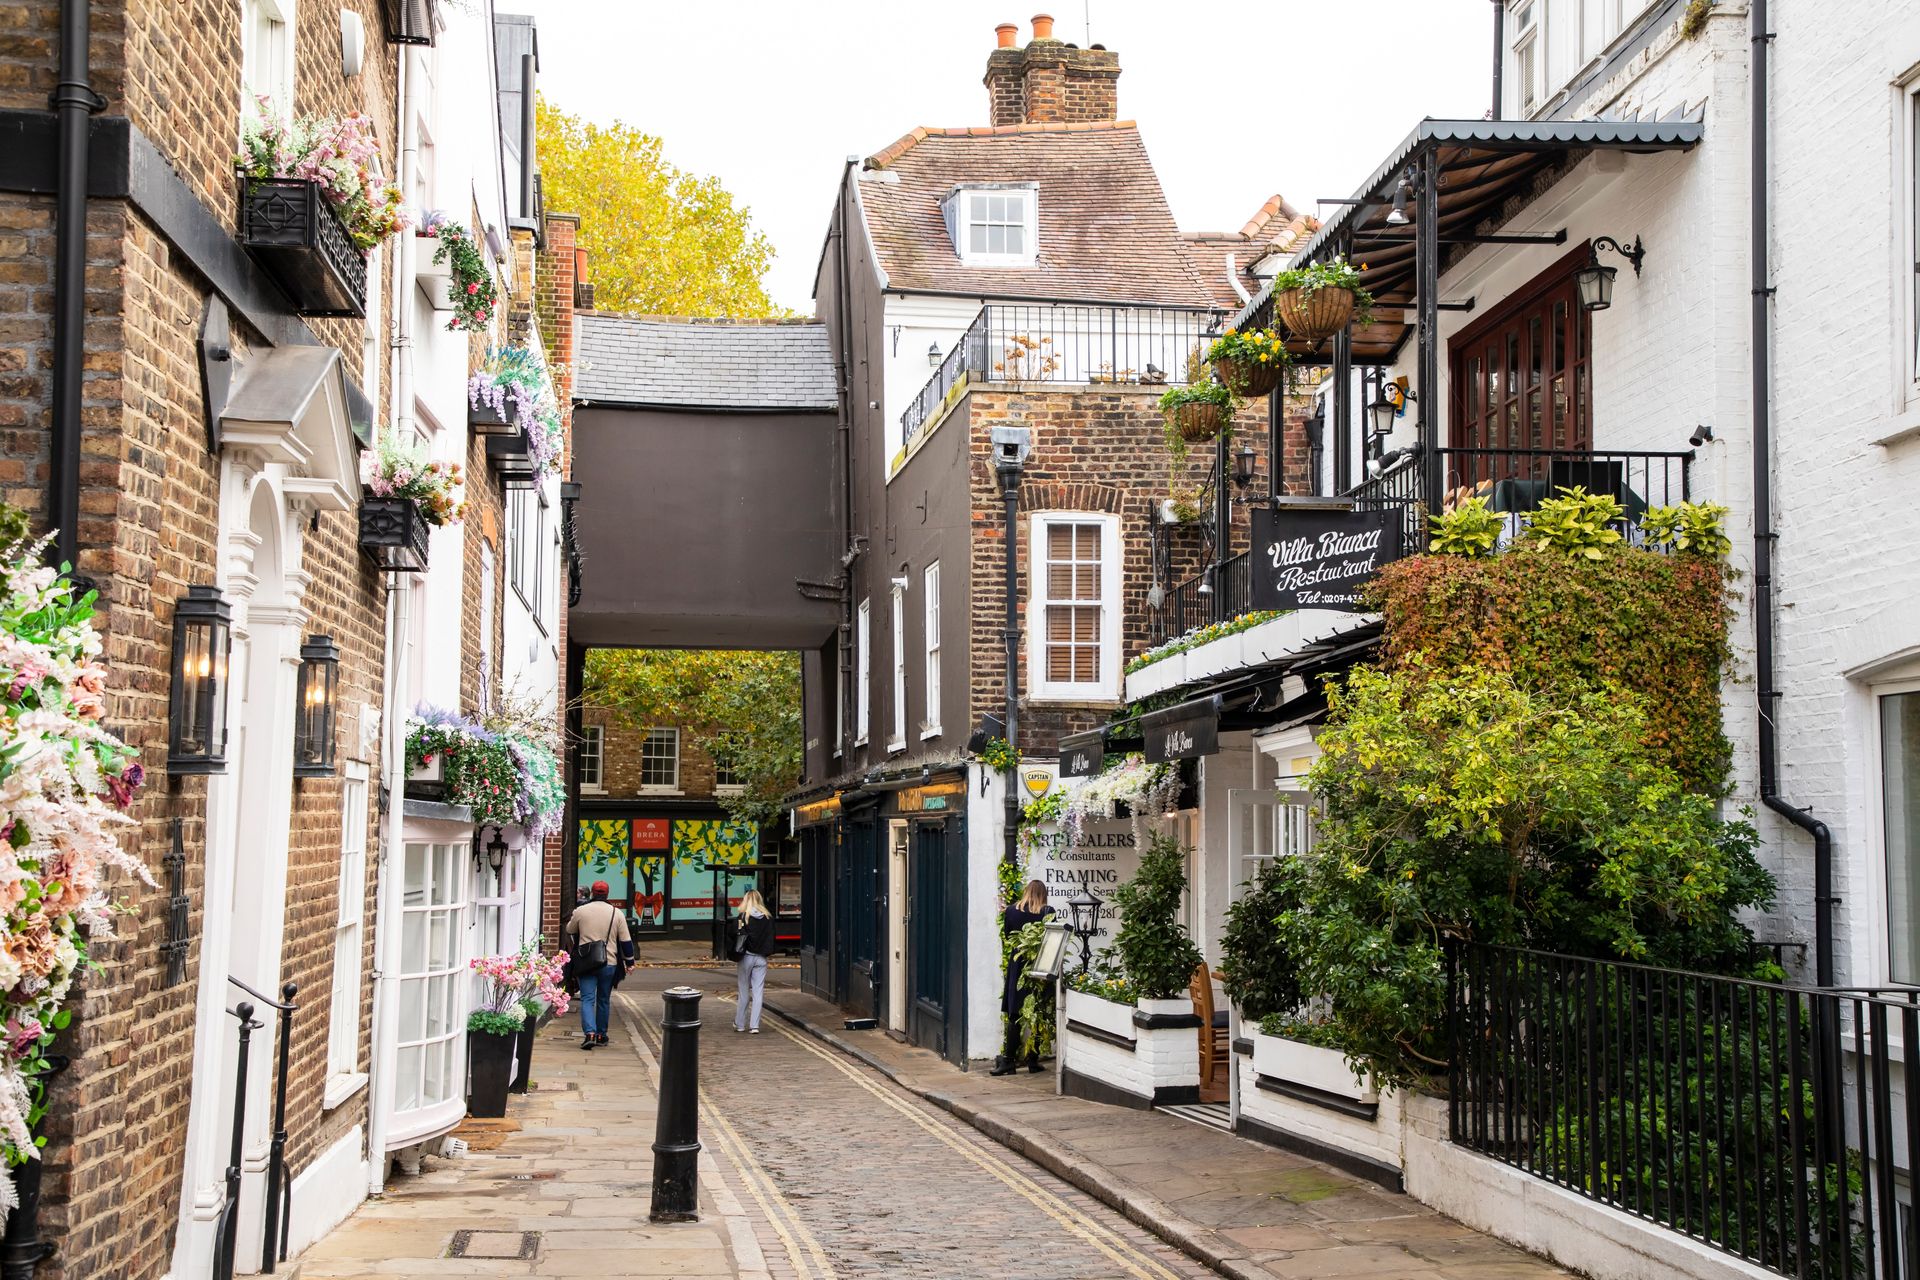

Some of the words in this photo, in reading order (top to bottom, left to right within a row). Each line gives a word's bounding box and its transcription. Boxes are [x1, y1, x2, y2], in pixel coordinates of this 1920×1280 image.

[1267, 537, 1315, 568] Villa
[1315, 529, 1382, 560] Bianca
[1276, 553, 1376, 592] Restaurant
[1045, 850, 1055, 861] &
[1059, 850, 1116, 861] Consultants
[1045, 868, 1118, 883] FRAMING
[1046, 886, 1088, 899] Hangin
